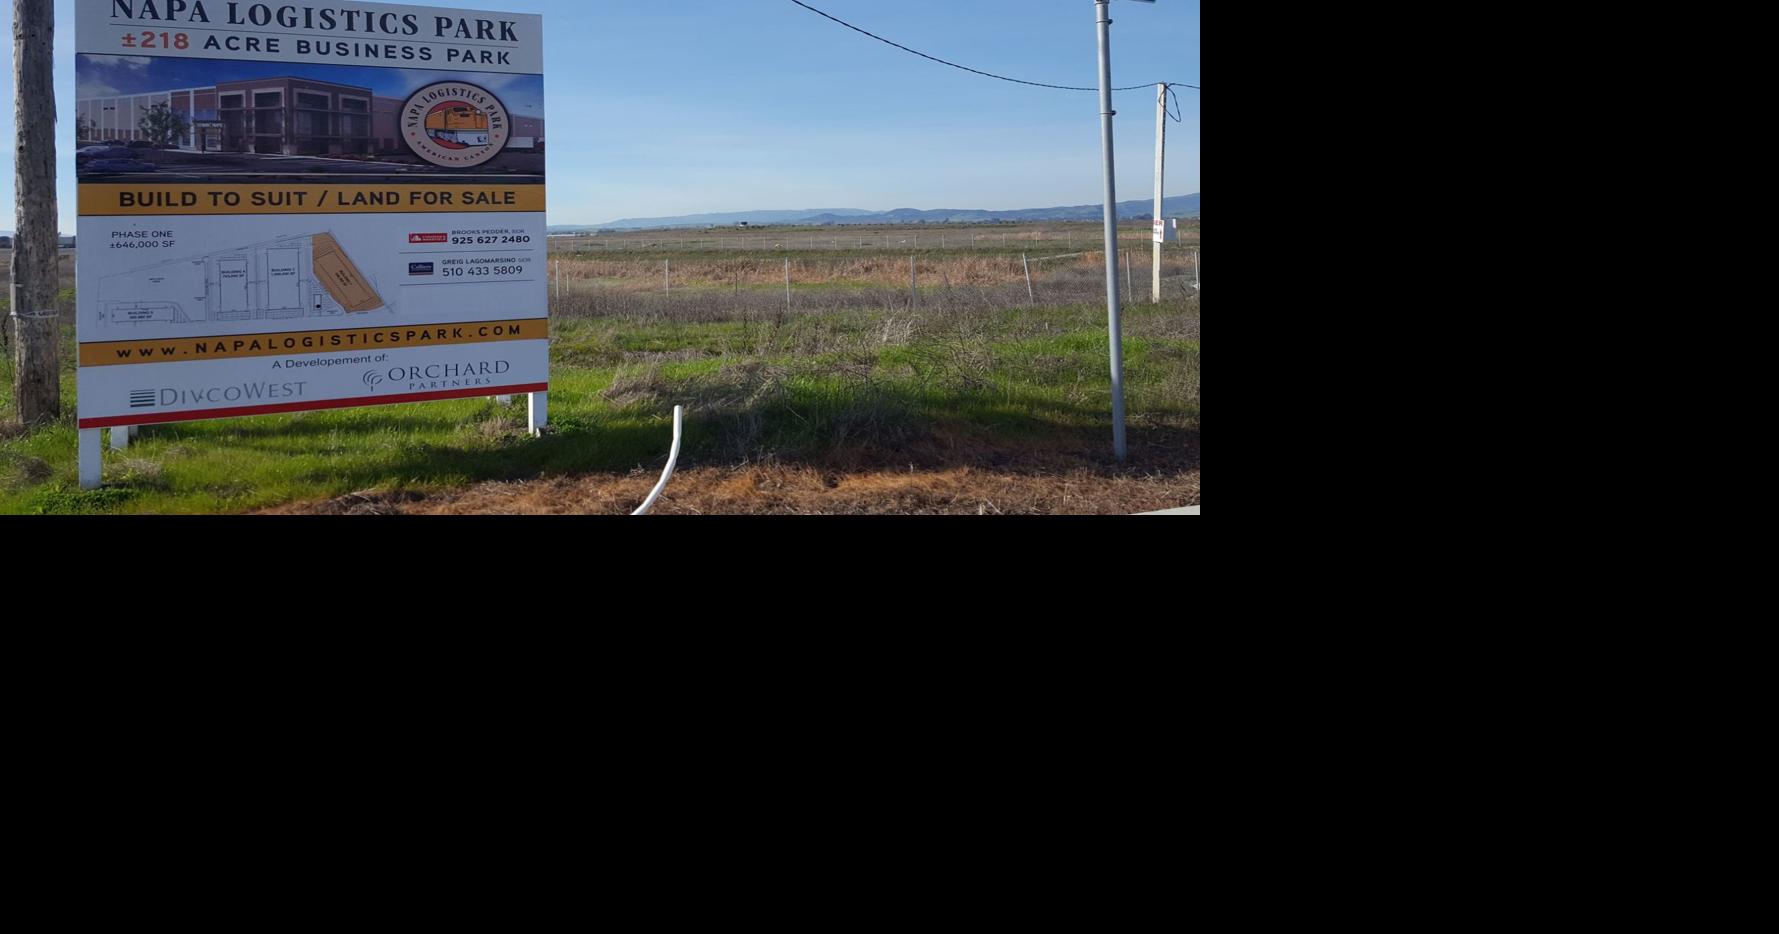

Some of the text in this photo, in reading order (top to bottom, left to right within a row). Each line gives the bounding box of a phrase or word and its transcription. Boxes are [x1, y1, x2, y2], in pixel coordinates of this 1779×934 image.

[110, 0, 519, 42] NAPA LOGISTICS PARK
[121, 31, 511, 65] ±218 ACRE BUSINESS PARK
[407, 87, 503, 130] NAPA LOGISTICS PARK
[119, 190, 516, 208] BUILD TO SUIT / LAND FOR SALE
[111, 230, 174, 239] PHASE ONE
[451, 236, 474, 245] 925
[476, 236, 498, 244] 627
[501, 235, 531, 243] 2480
[109, 240, 176, 249] ±646,000 SF
[465, 257, 517, 265] LAGOMARSINO
[442, 265, 524, 277] 510 433 5809
[271, 353, 390, 370] A Developement of:
[388, 359, 511, 382] ORCHARD
[408, 377, 494, 391] PARTNERS
